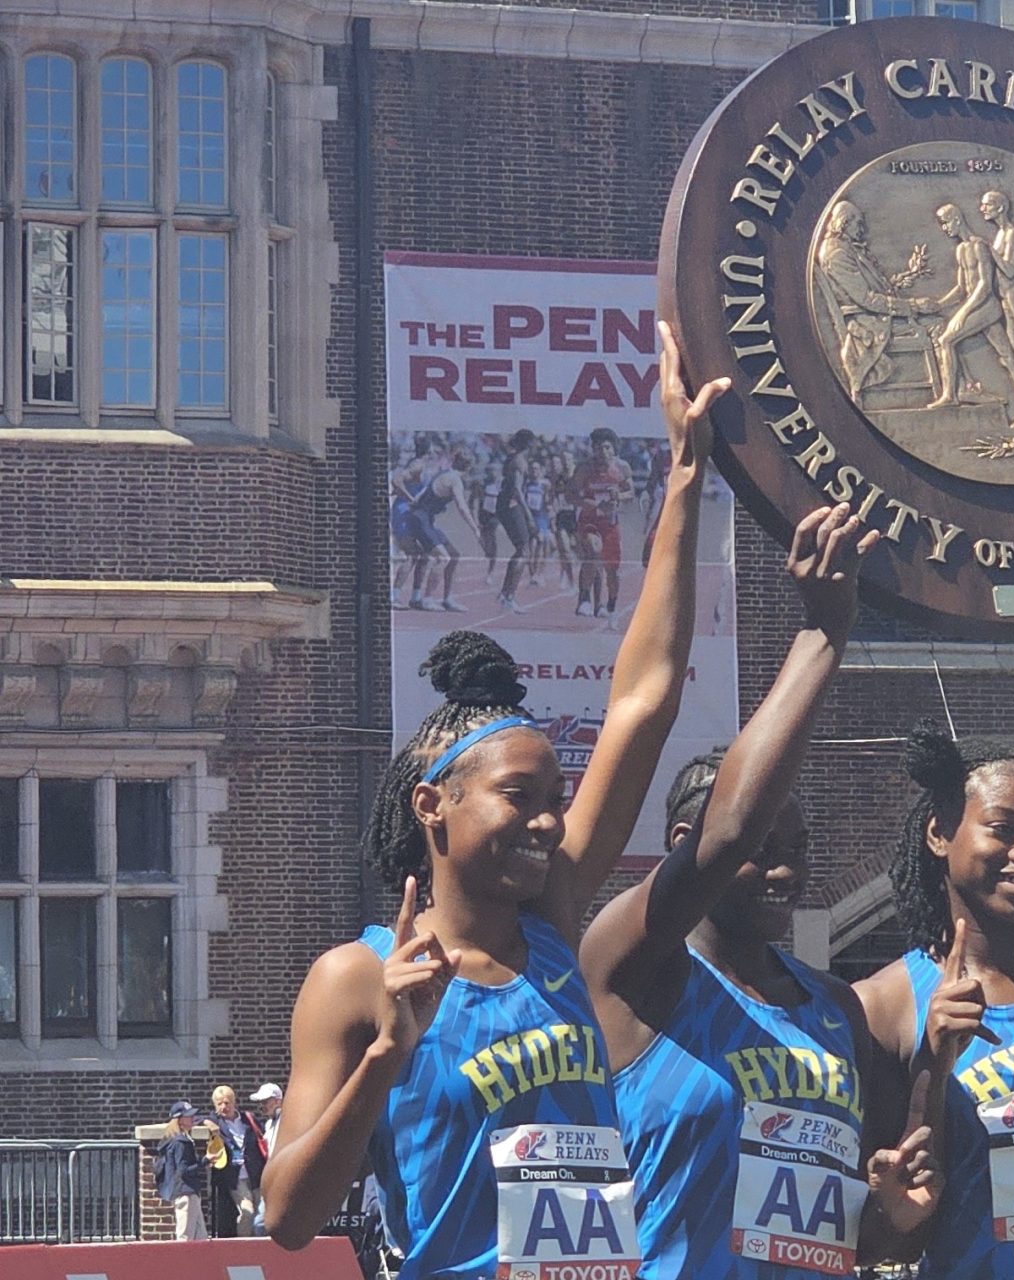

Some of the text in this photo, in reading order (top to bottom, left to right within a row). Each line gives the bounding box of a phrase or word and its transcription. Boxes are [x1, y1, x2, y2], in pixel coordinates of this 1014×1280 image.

[730, 71, 868, 217] RELAY
[890, 161, 957, 174] FOUNDED
[400, 321, 485, 348] THE
[721, 252, 965, 564] UNIVERSITY
[973, 538, 1014, 571] OF
[460, 1024, 606, 1113] HYDEL
[725, 1047, 864, 1122] HYDEL
[555, 1131, 597, 1145] PENN
[801, 1118, 844, 1139] PENN
[555, 1146, 610, 1161] RELAYS
[761, 1145, 820, 1164] Dream On.
[798, 1131, 849, 1156] RELAYS
[520, 1168, 576, 1180] Dream On.
[755, 1166, 846, 1242] AA
[522, 1188, 625, 1257] AA
[775, 1240, 845, 1270] TOYOTA
